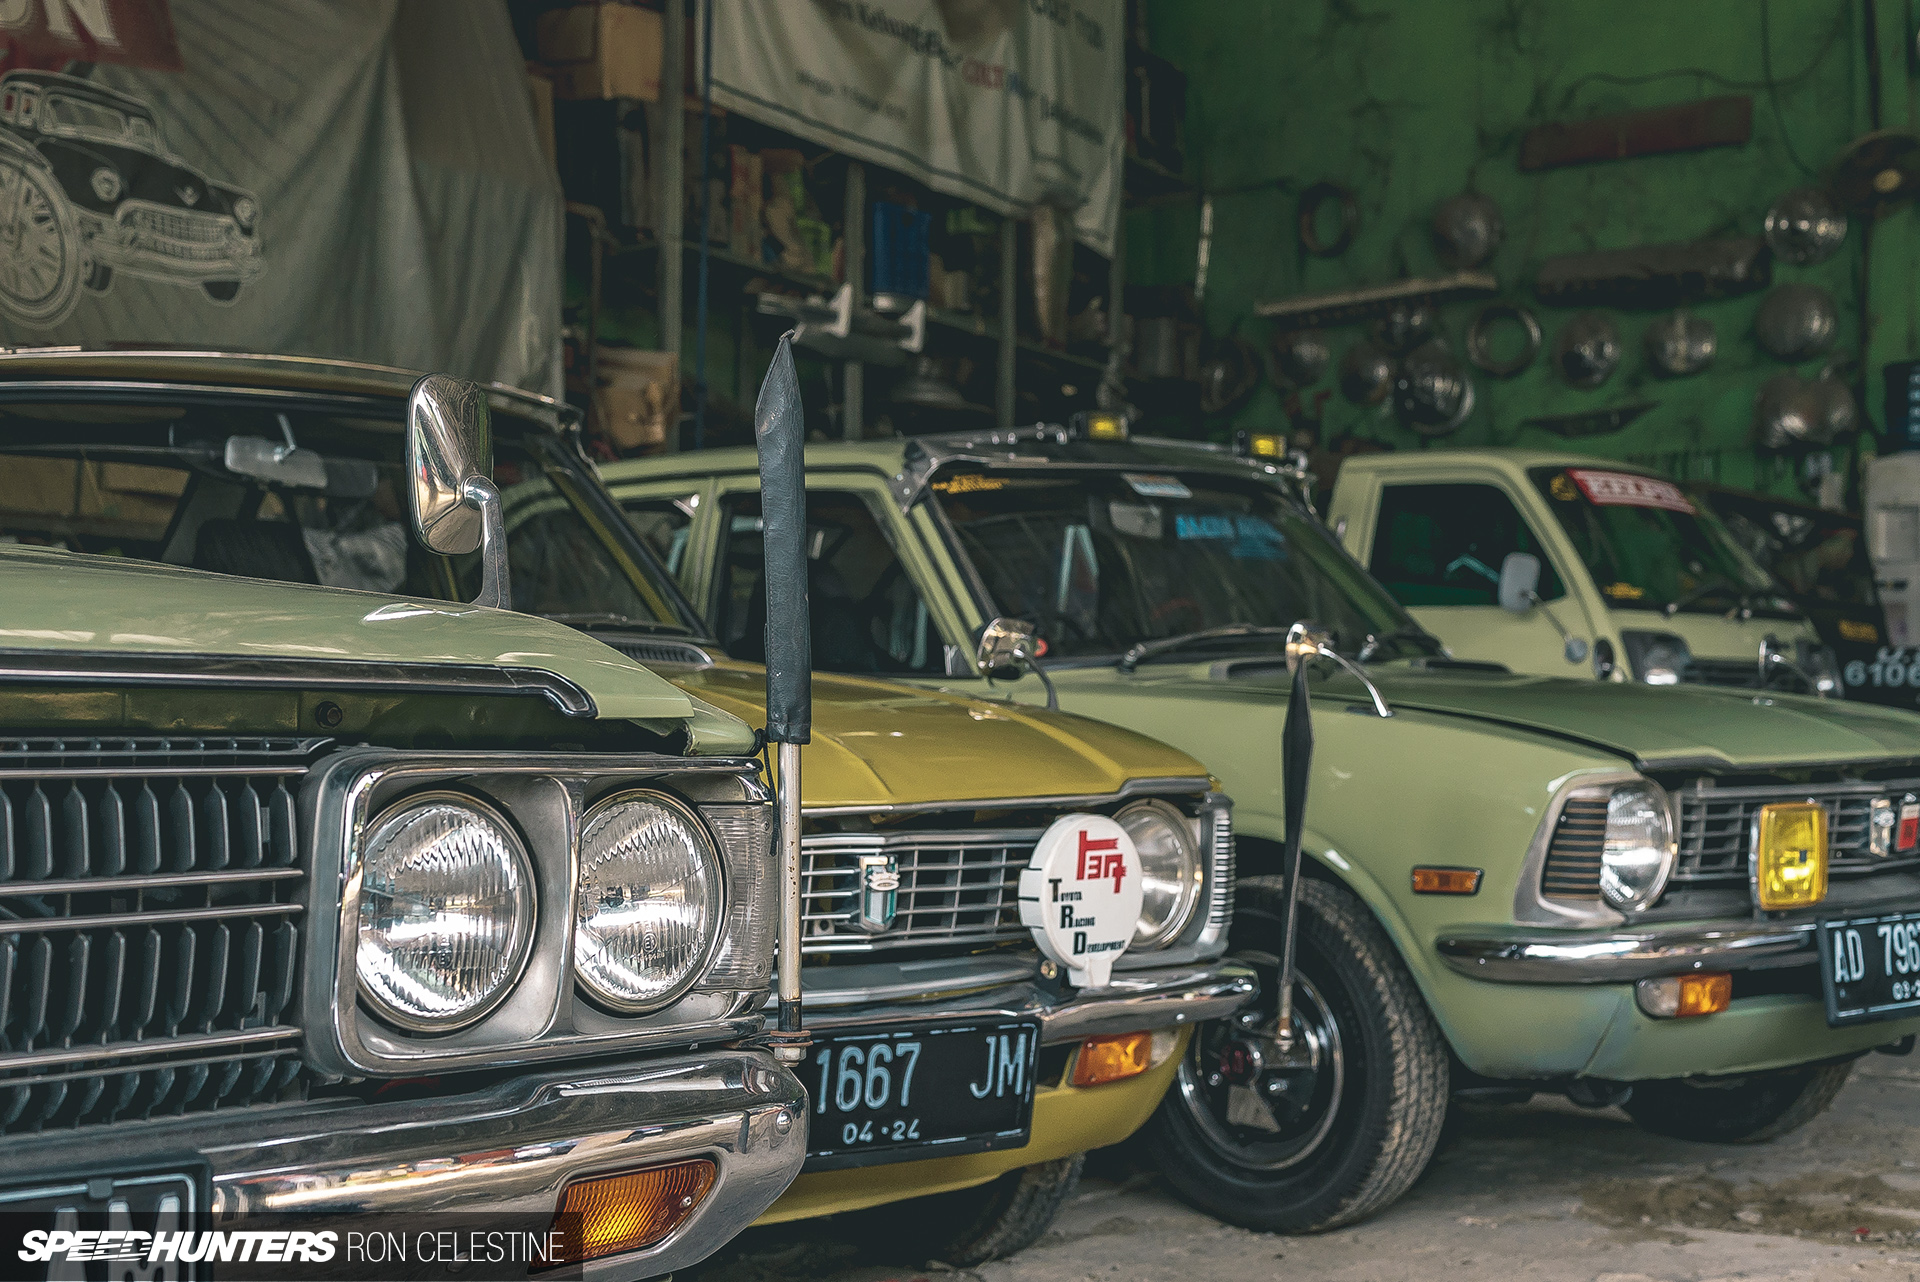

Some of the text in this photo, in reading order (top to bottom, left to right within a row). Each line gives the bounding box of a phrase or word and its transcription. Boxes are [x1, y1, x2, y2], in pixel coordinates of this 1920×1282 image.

[0, 0, 120, 47] N
[1060, 904, 1096, 929] RACING
[1073, 931, 1125, 955] DEVELOPMENT
[1834, 928, 1865, 983] AD
[816, 1033, 1027, 1114] 1667 JM
